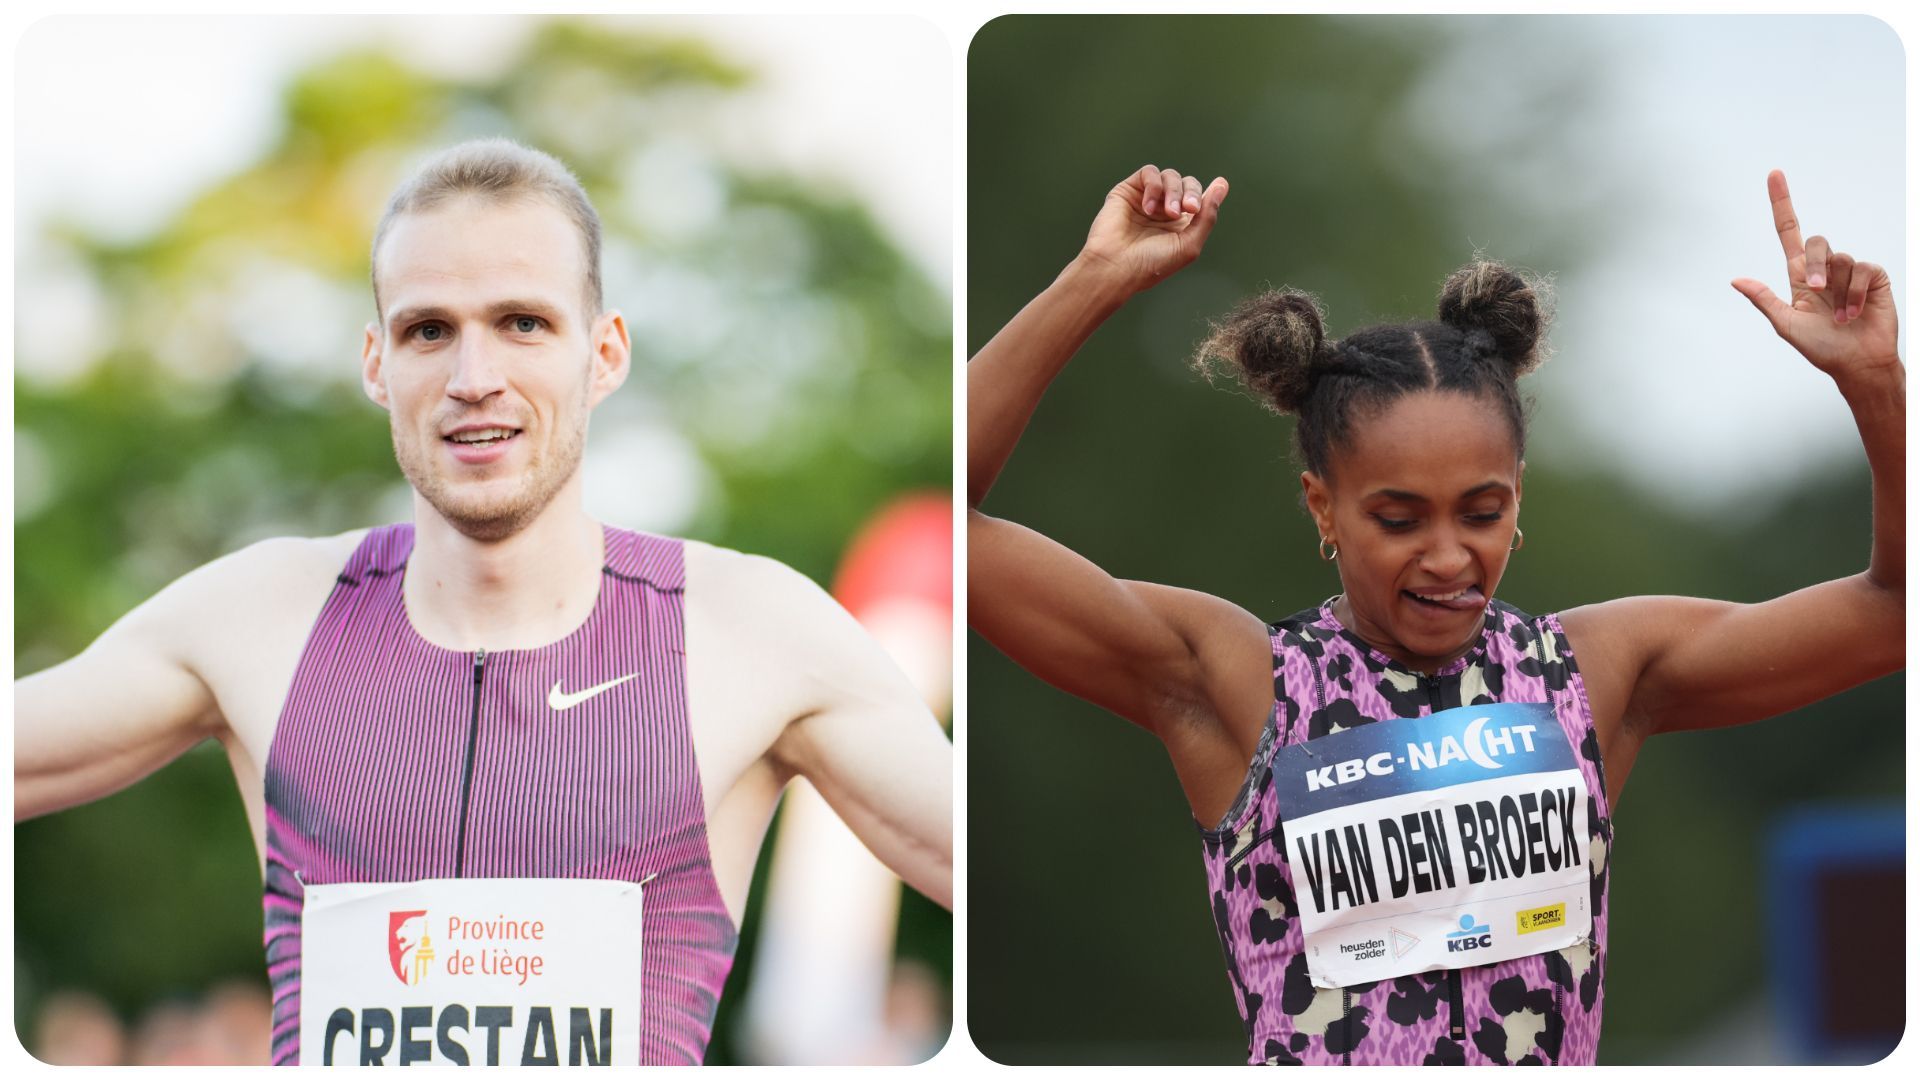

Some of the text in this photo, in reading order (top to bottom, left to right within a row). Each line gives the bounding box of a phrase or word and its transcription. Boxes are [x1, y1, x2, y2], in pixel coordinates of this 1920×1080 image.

[1296, 787, 1581, 914] VAN DEN BROECK
[447, 914, 545, 940] Province
[1340, 939, 1385, 954] heusden
[1354, 948, 1386, 961] zolder
[1447, 934, 1492, 952] KBC
[447, 949, 475, 975] de
[323, 1004, 612, 1066] CRESTAN
